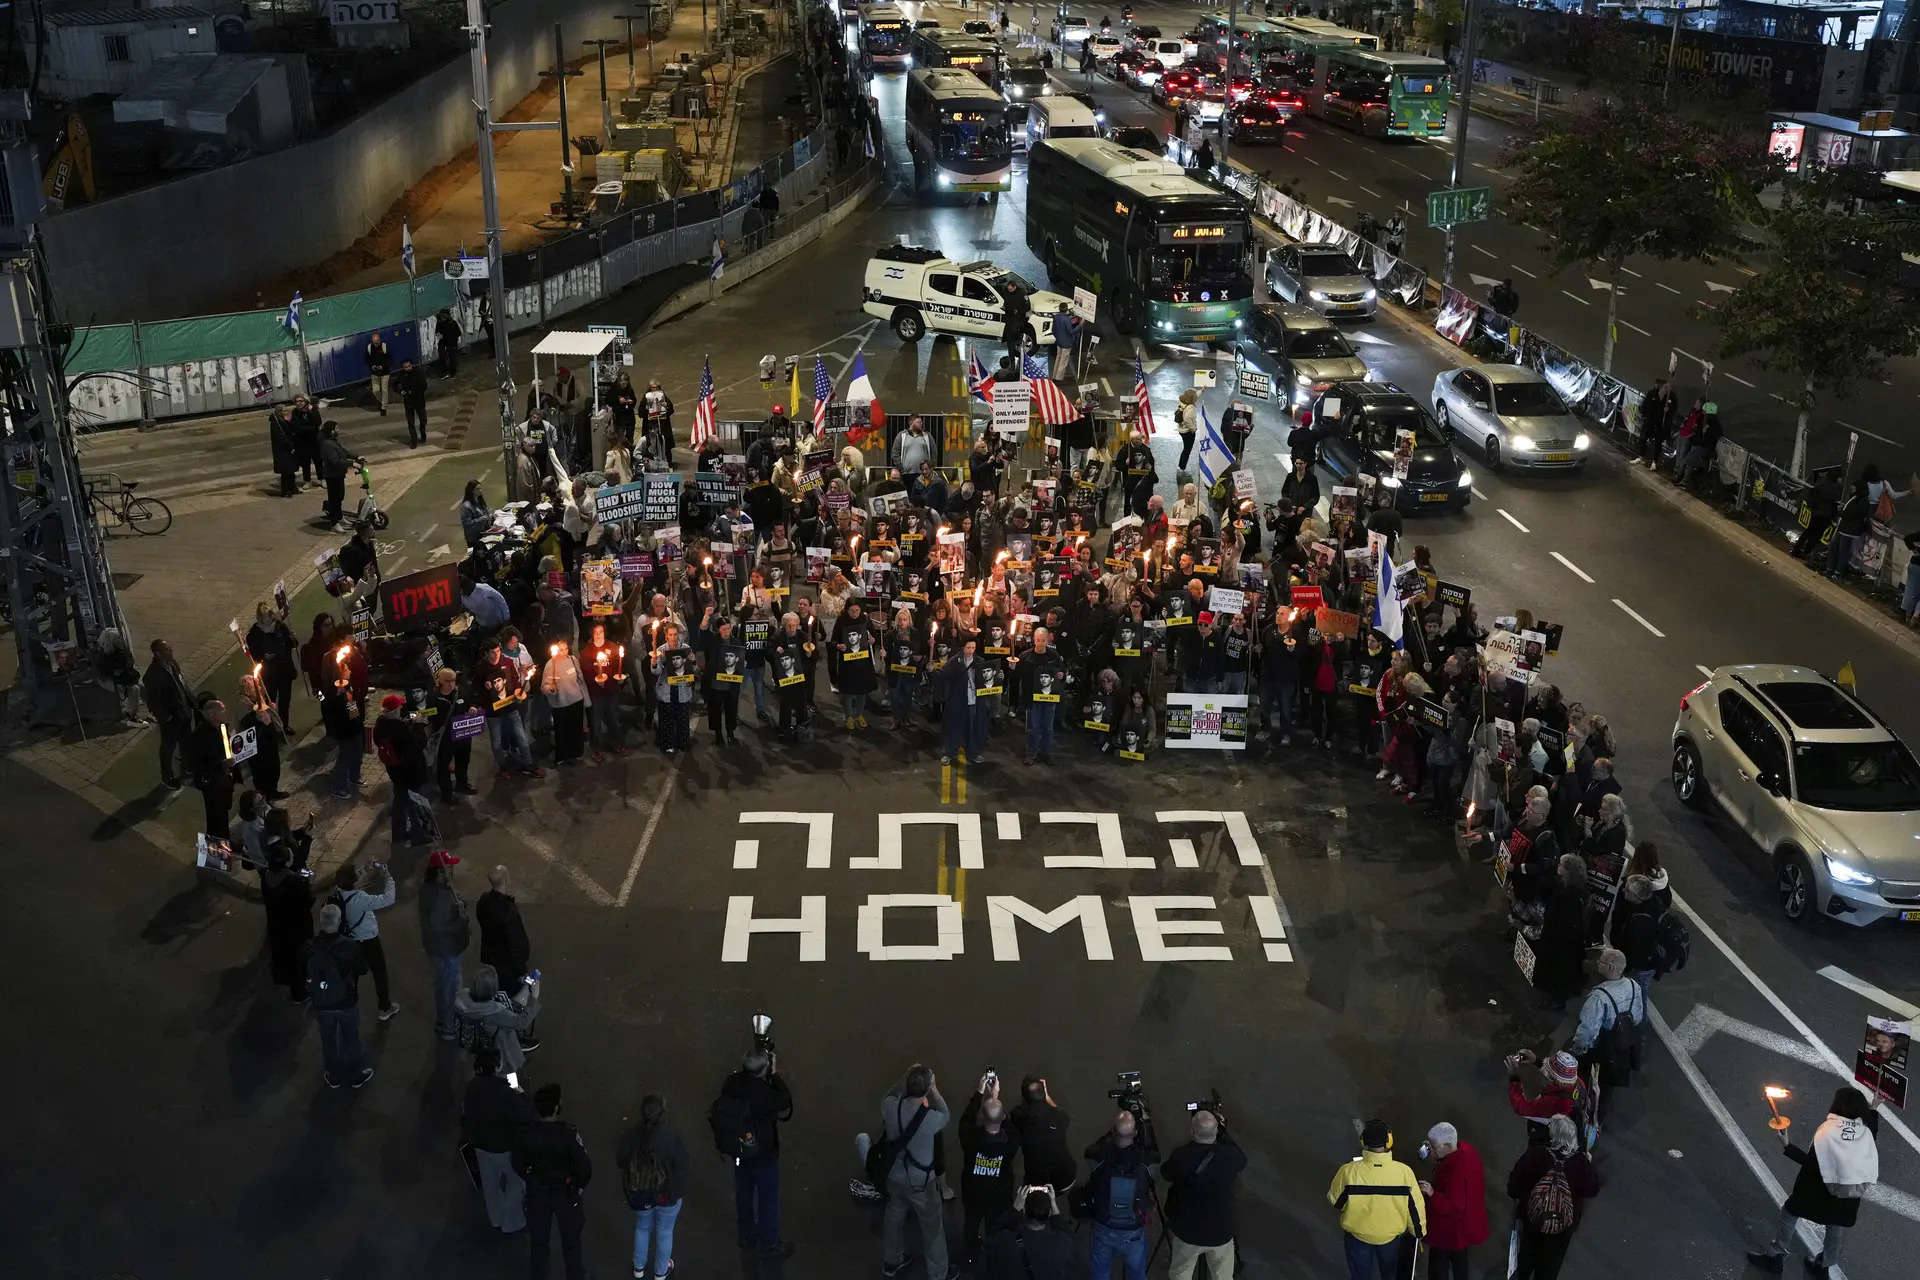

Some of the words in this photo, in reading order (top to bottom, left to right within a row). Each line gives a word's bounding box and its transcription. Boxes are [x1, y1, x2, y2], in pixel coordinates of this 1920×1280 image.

[1711, 51, 1774, 80] TOWER
[56, 161, 69, 200] JCB
[929, 303, 954, 314] ישראל
[935, 313, 953, 321] POLICE
[963, 309, 994, 320] משטרת
[650, 481, 674, 489] HOW
[697, 481, 712, 490] עוד
[648, 488, 675, 496] MUCH
[597, 494, 619, 510] END
[620, 489, 642, 504] THE
[647, 496, 676, 504] BLOOD
[598, 503, 644, 522] BLOODSHED
[645, 505, 666, 513] WILL
[667, 505, 677, 513] BE
[645, 513, 678, 521] SPILLED?
[1442, 588, 1464, 599] עסקה
[393, 579, 452, 621] הצילו!
[745, 623, 755, 632] הם
[755, 623, 769, 632] למה
[1424, 706, 1443, 720] עסקה
[733, 811, 1265, 871] הביתה
[721, 895, 1294, 962] HOME!
[975, 1157, 1003, 1168] HOME!
[973, 1165, 1001, 1177] NOW!
